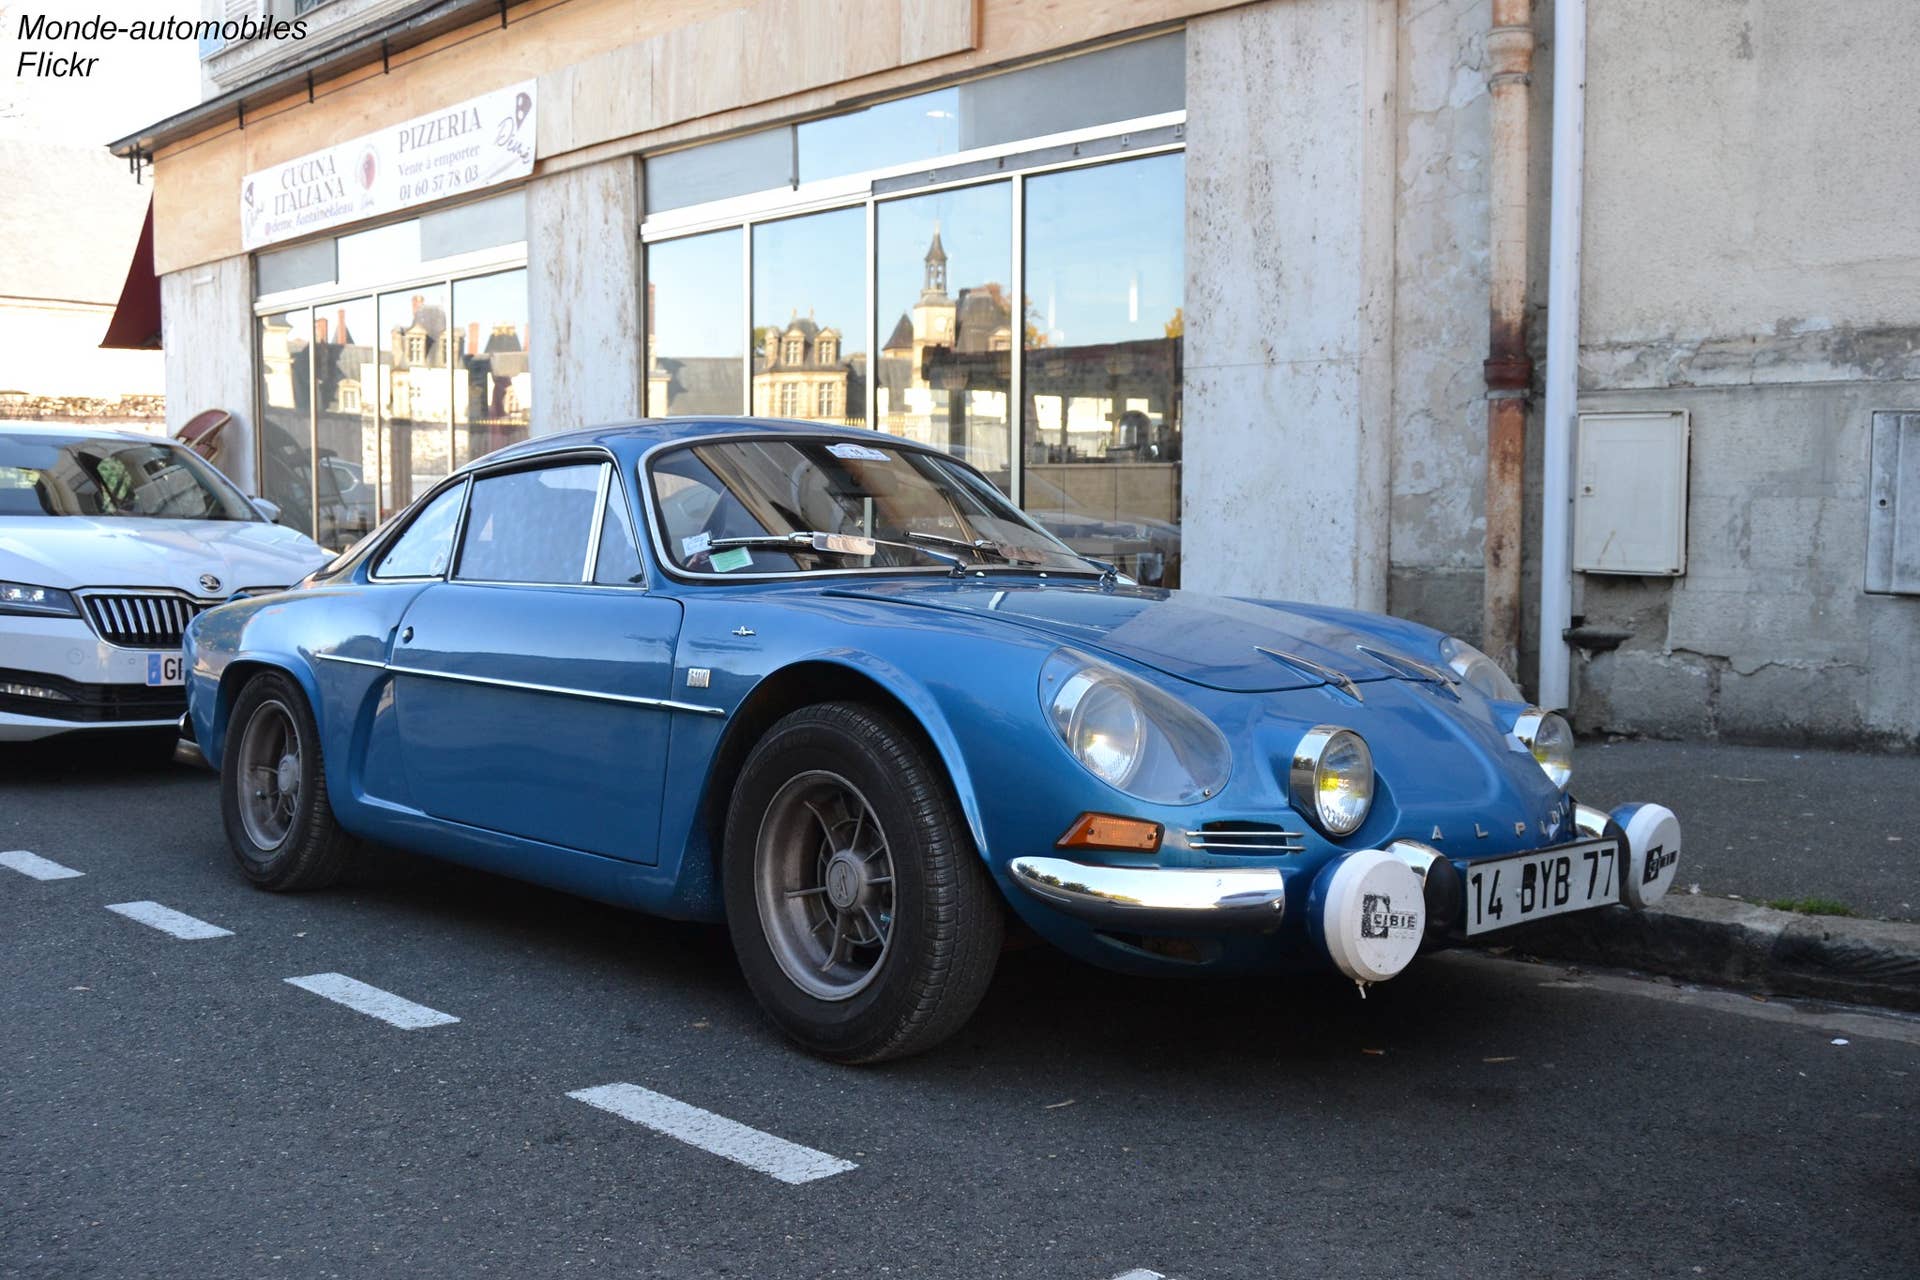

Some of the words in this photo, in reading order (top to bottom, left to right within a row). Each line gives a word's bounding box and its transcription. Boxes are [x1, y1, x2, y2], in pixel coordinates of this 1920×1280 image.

[398, 106, 483, 154] PIZZERIA
[280, 154, 337, 190] CUCINA
[398, 160, 424, 177] Vente
[433, 144, 481, 169] emporter
[399, 184, 411, 201] 01
[415, 178, 429, 196] 60
[432, 173, 446, 192] 57
[448, 170, 461, 188] 78
[464, 165, 479, 184] 03
[1471, 868, 1503, 925] 14
[1520, 857, 1572, 914] BYB
[1583, 849, 1615, 899] 77
